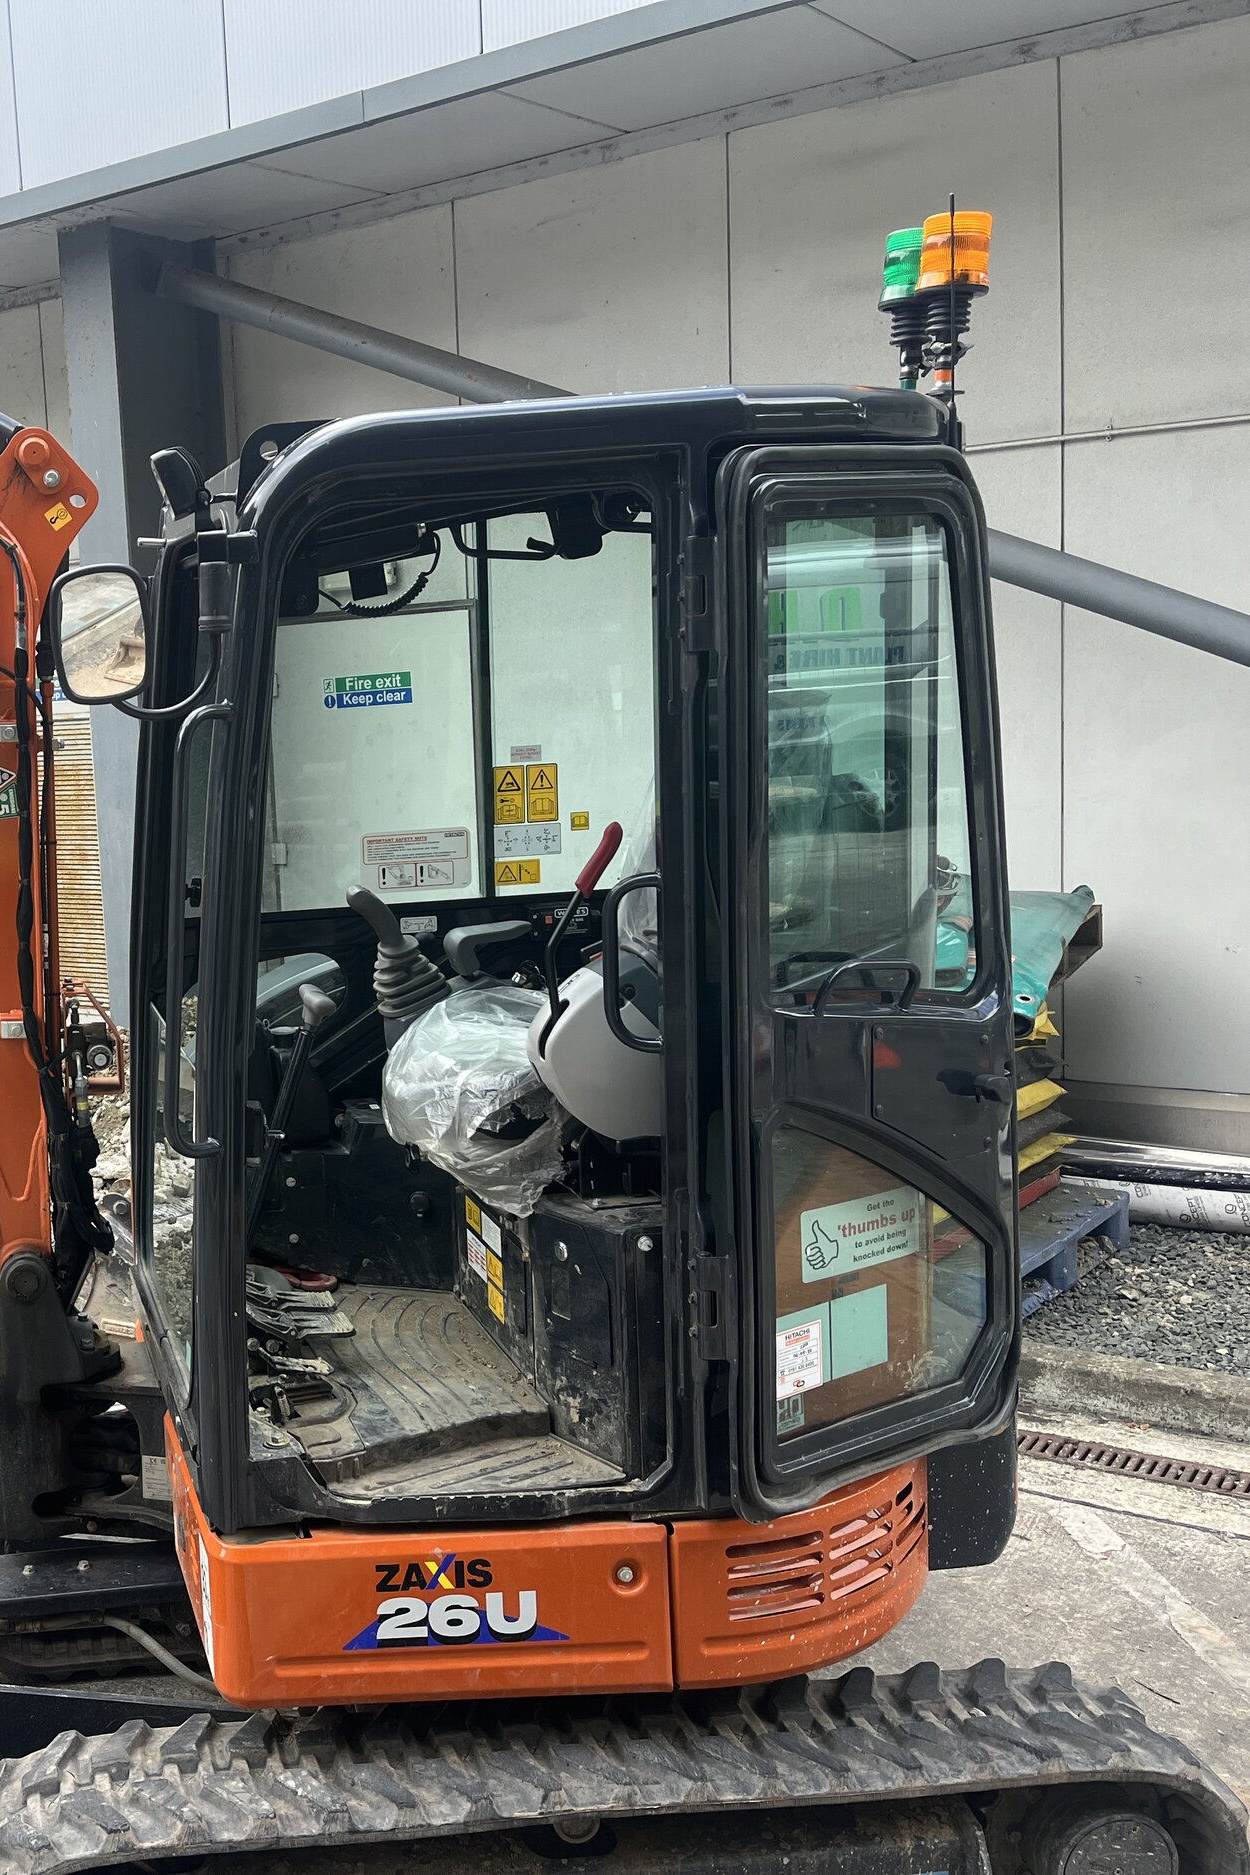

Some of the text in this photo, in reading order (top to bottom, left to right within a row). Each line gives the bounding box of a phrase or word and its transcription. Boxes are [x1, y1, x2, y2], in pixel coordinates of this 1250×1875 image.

[345, 674, 402, 691] Fire exit
[343, 690, 406, 706] Keep clear
[866, 1199, 895, 1212] Get the
[855, 1228, 907, 1249] to avoid being
[853, 1247, 885, 1262] knocked
[785, 1327, 811, 1341] HITACHI
[375, 1553, 493, 1592] ZAXIS
[376, 1590, 538, 1647] 26U
